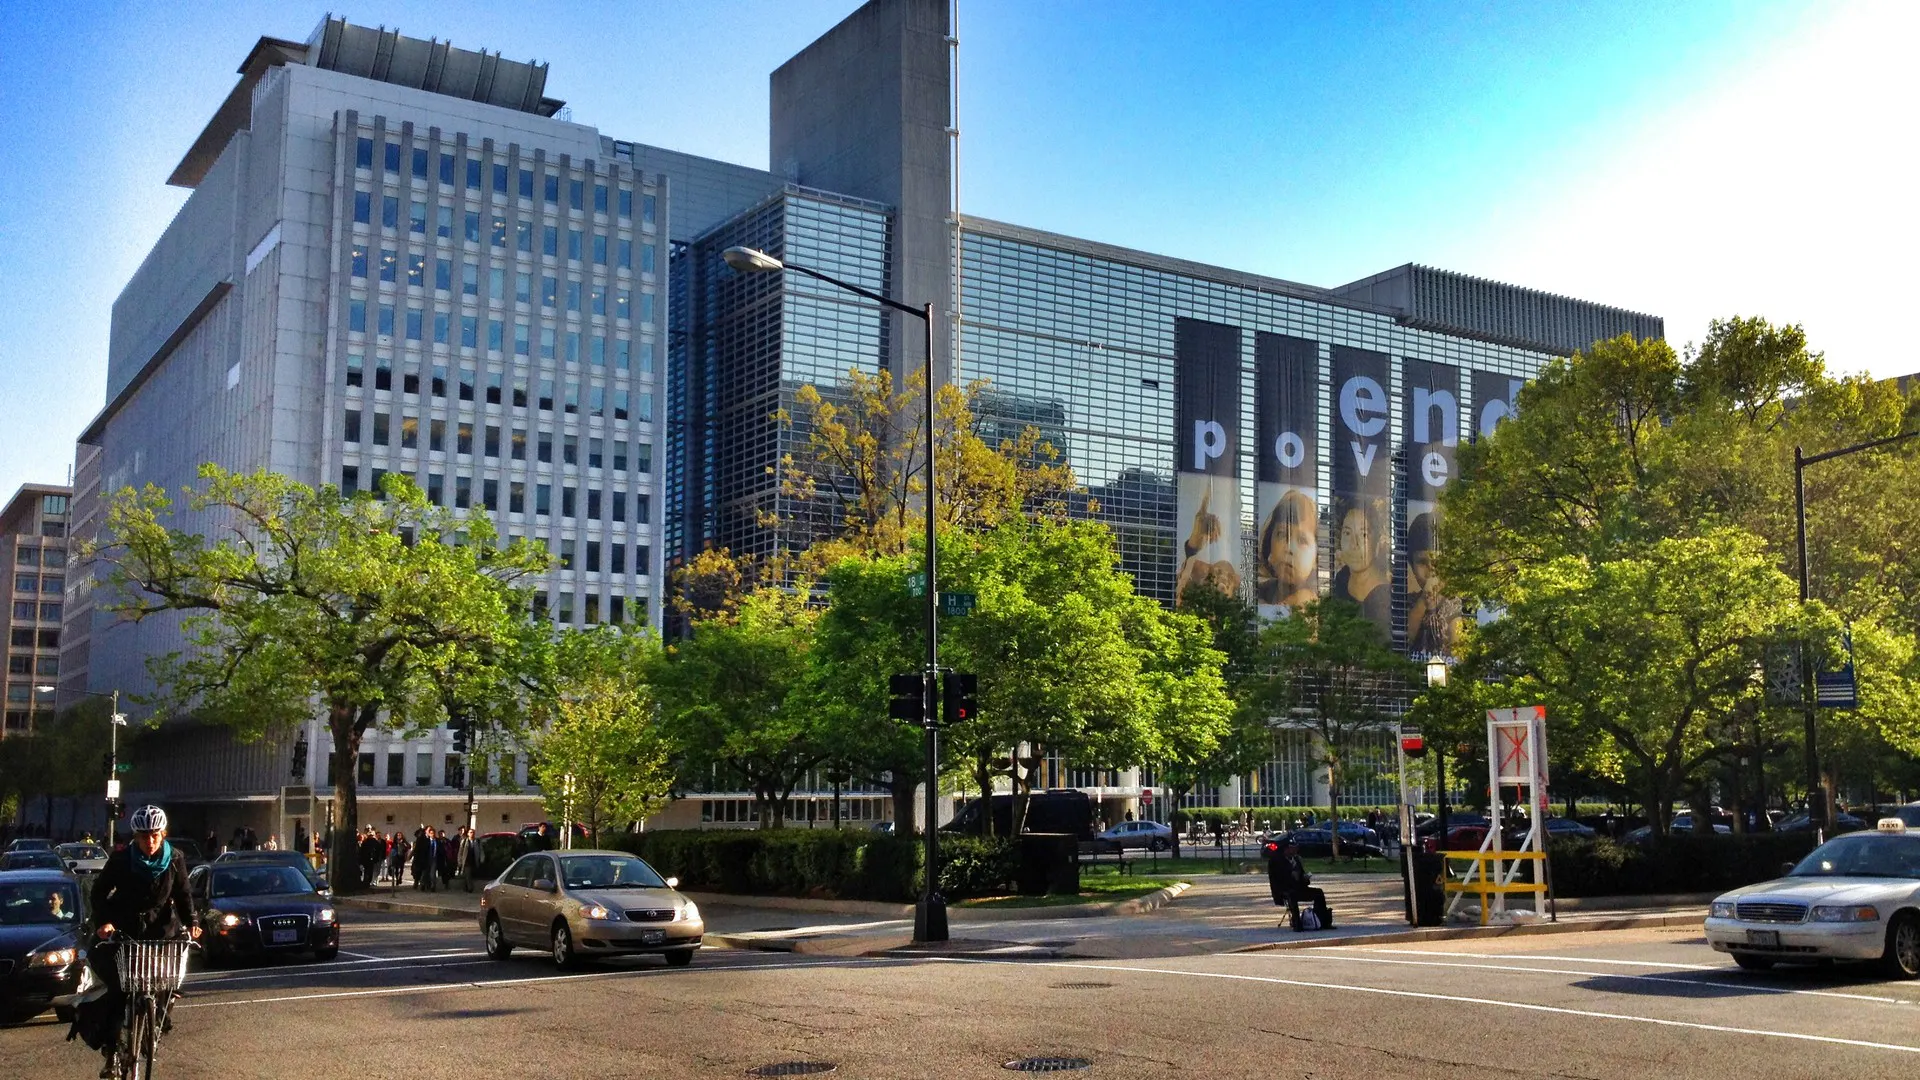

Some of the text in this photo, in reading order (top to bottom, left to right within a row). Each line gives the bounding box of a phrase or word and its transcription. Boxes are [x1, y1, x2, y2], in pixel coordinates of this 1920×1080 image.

[907, 576, 916, 588] 18
[948, 595, 957, 606] H
[947, 606, 966, 615] 1800
